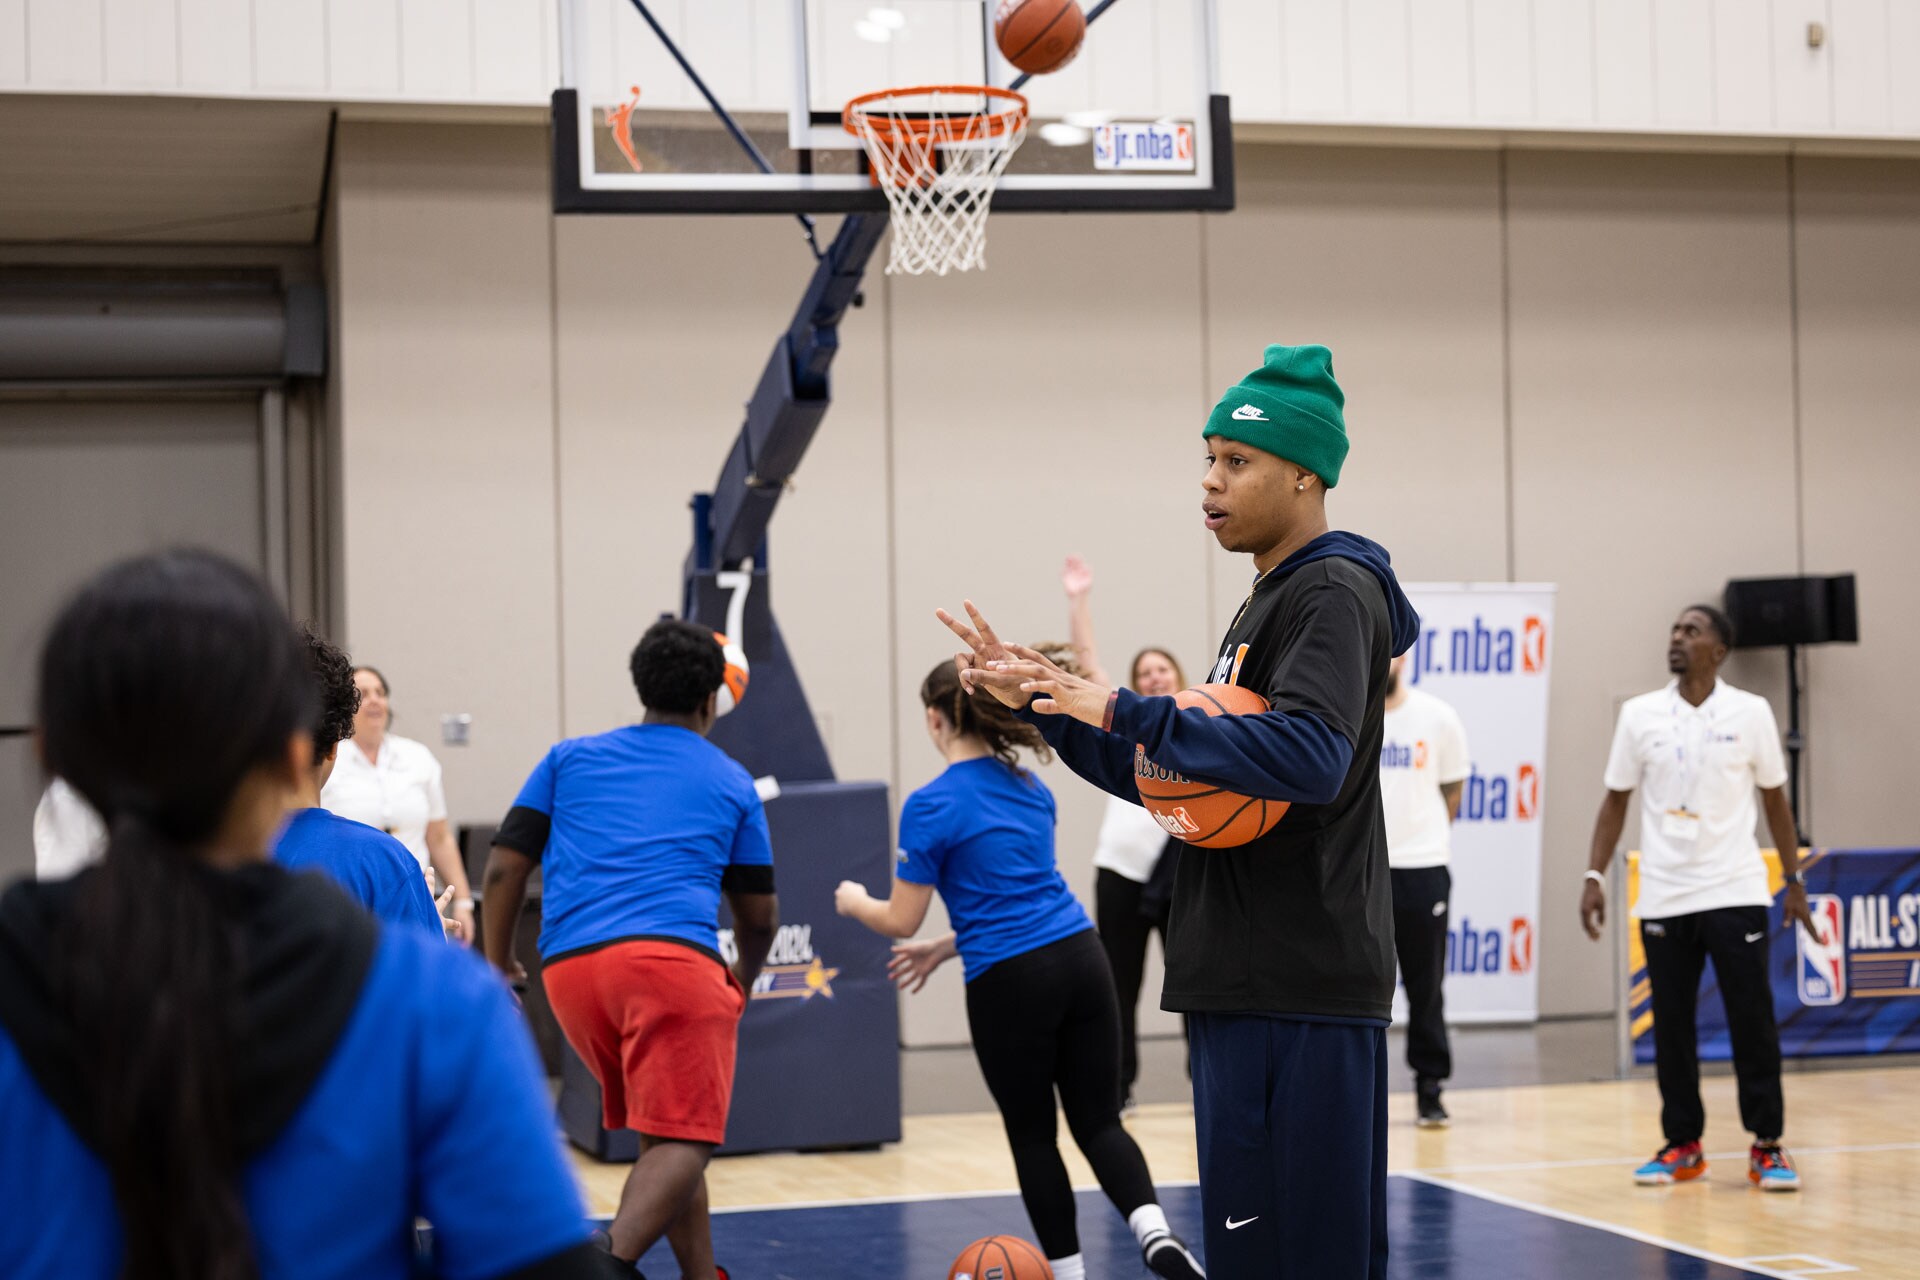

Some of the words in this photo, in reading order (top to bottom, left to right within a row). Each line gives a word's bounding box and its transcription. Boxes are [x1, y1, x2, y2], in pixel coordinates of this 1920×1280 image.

[1113, 125, 1173, 167] jr.nba
[1238, 403, 1264, 417] NIKE
[716, 571, 751, 647] 7
[1411, 616, 1514, 685] jr.nba
